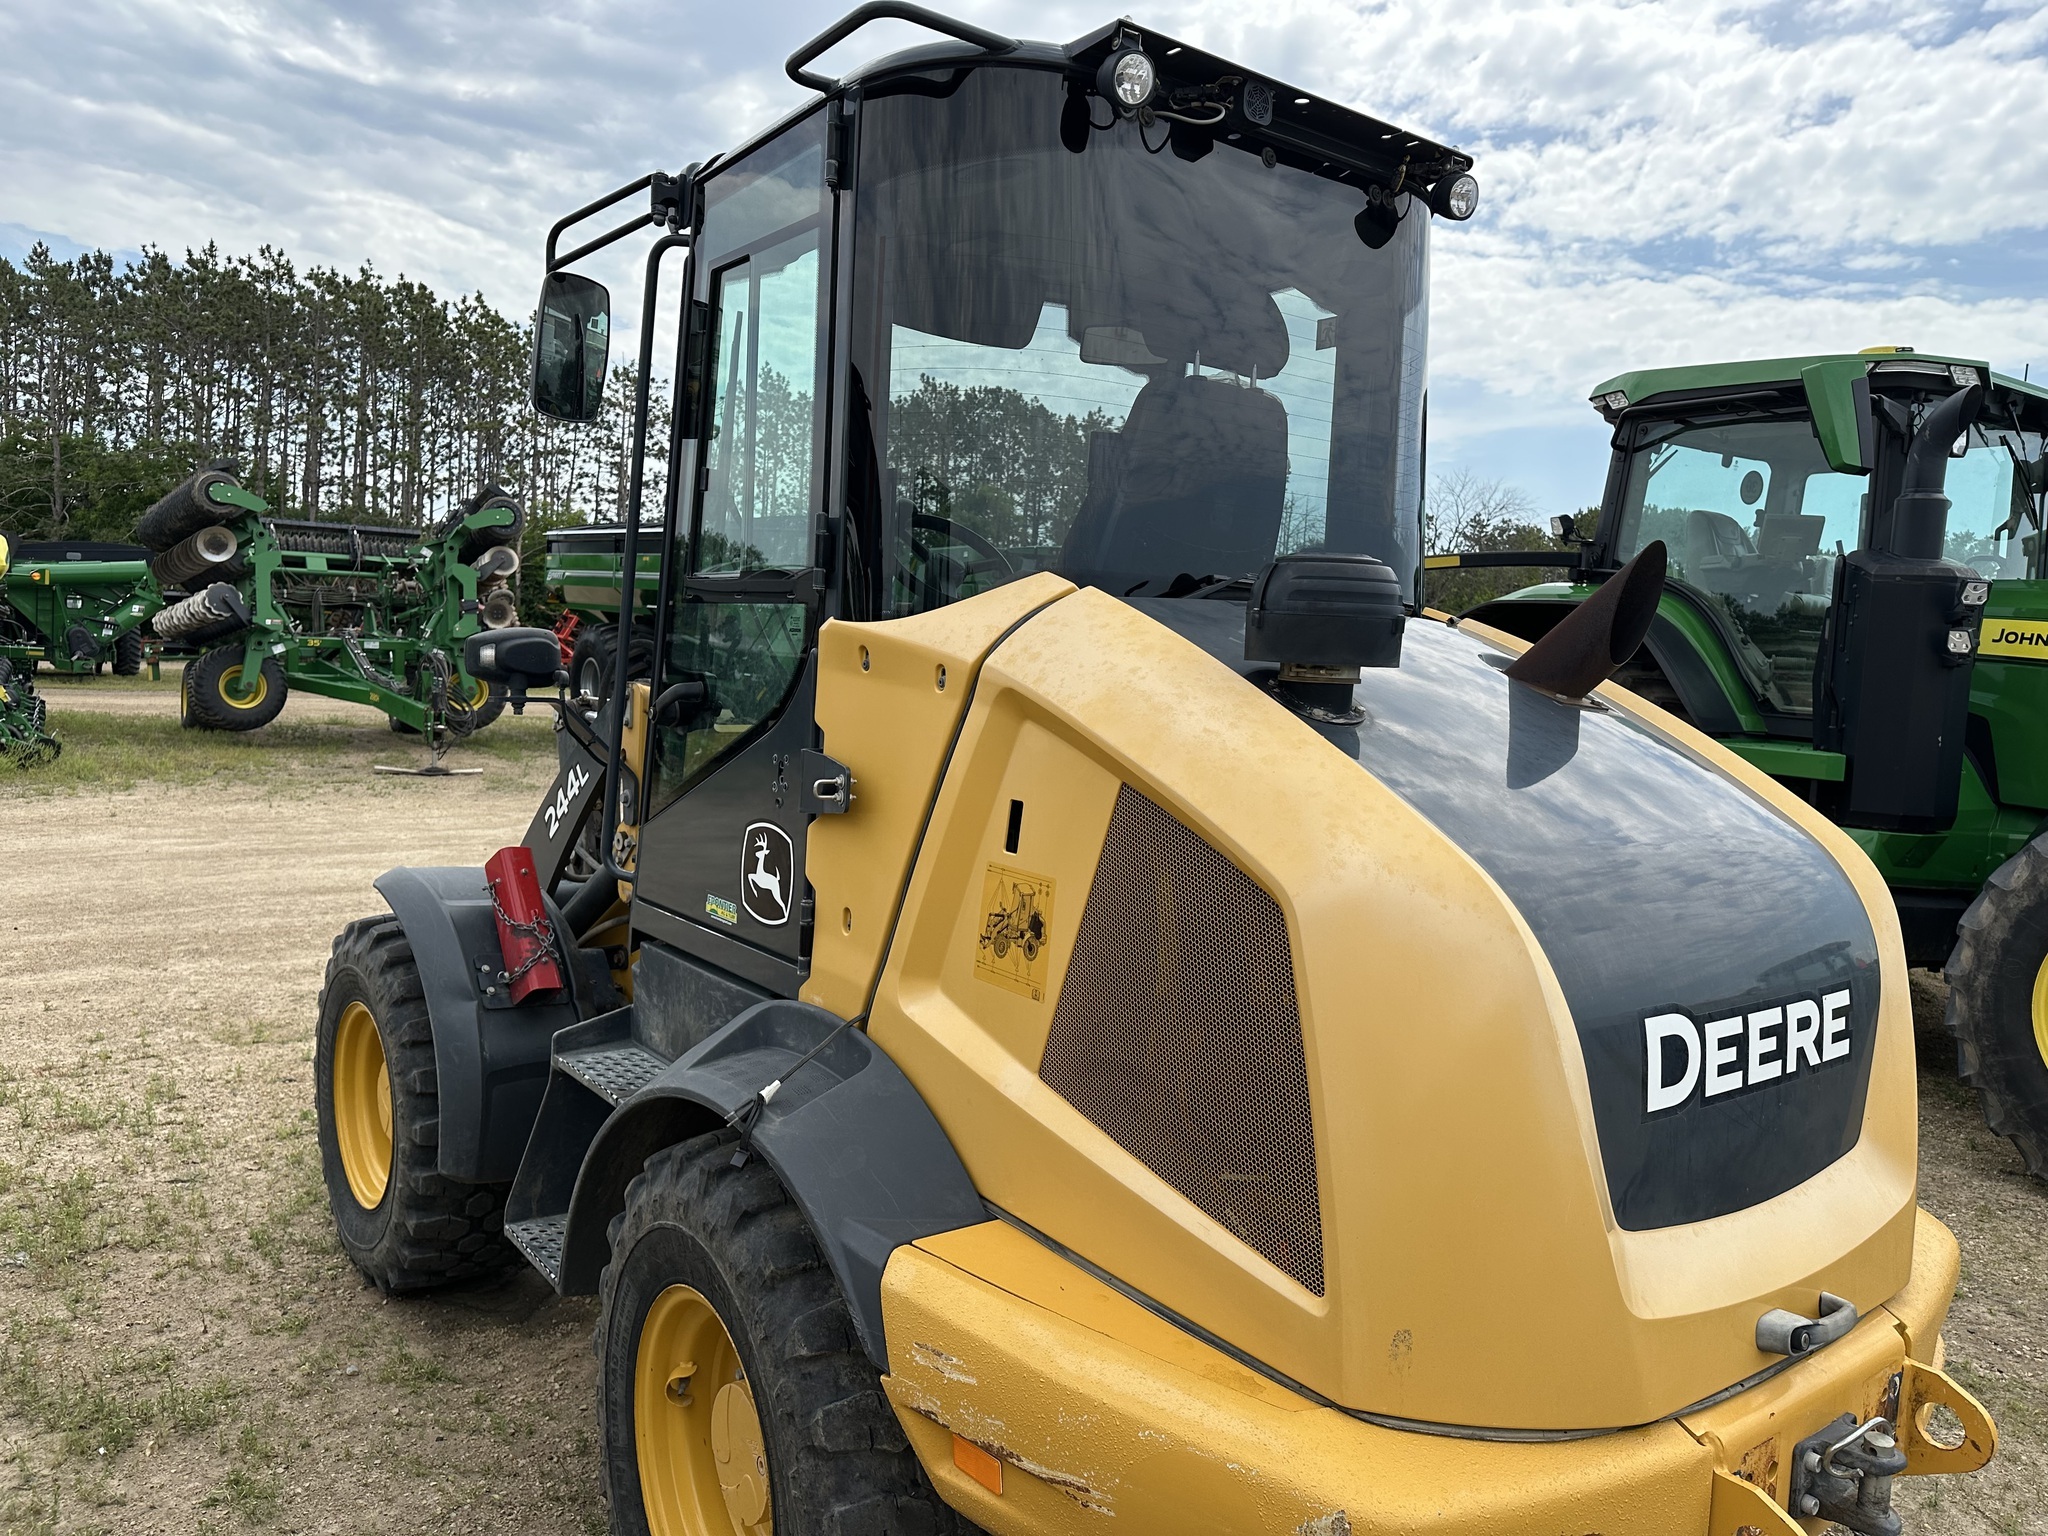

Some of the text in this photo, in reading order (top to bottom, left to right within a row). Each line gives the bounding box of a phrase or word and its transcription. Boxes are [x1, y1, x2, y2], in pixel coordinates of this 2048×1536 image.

[1991, 628, 2048, 646] JOHN
[544, 763, 590, 840] 244L
[707, 894, 737, 914] FRONTIER
[1644, 989, 1851, 1113] DEERE
